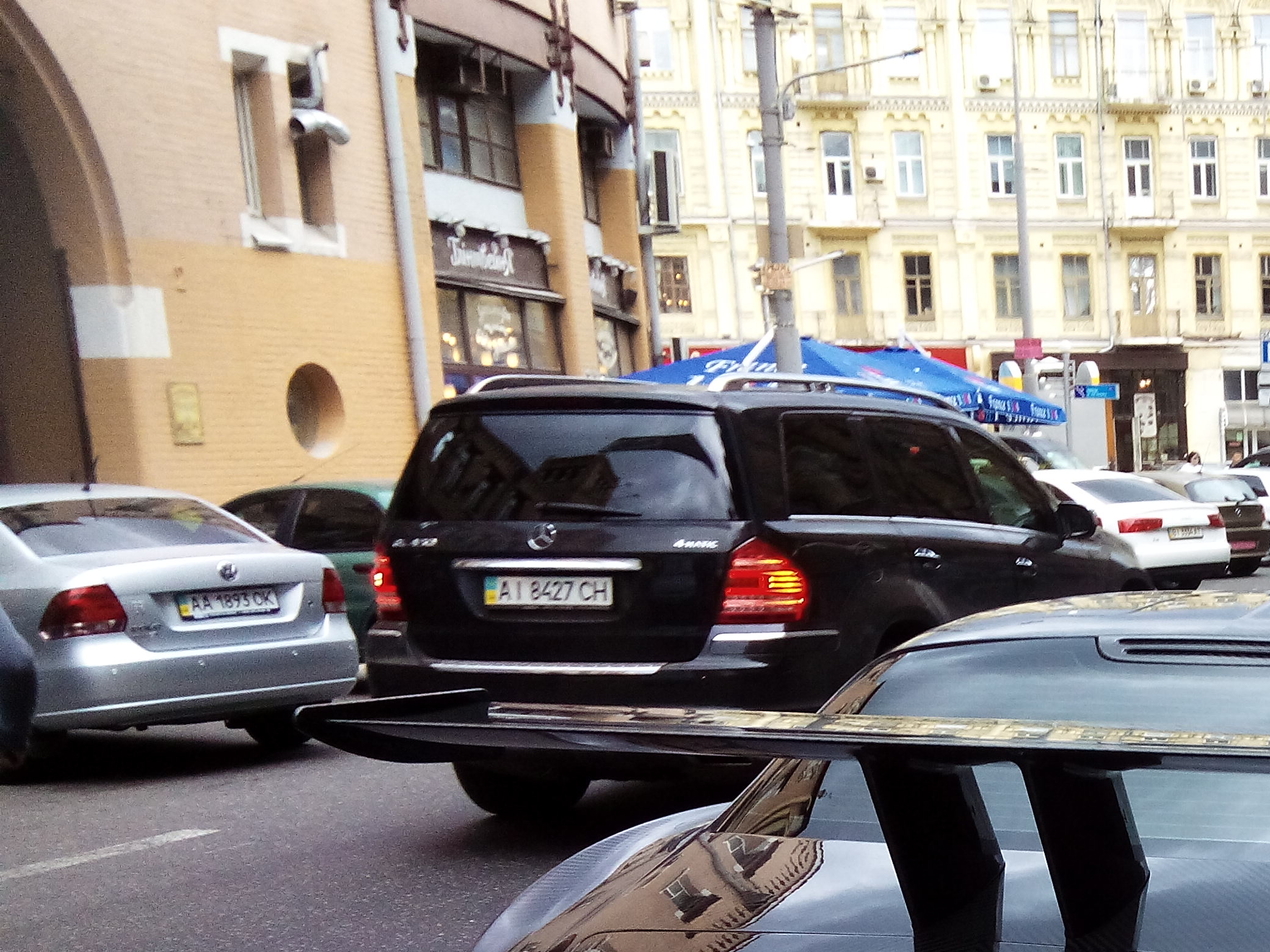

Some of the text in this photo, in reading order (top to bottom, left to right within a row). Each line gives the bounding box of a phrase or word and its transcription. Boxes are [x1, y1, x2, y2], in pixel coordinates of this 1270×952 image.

[500, 580, 608, 602] AI 8427 CH
[191, 595, 214, 612] AA
[216, 592, 250, 609] 1893
